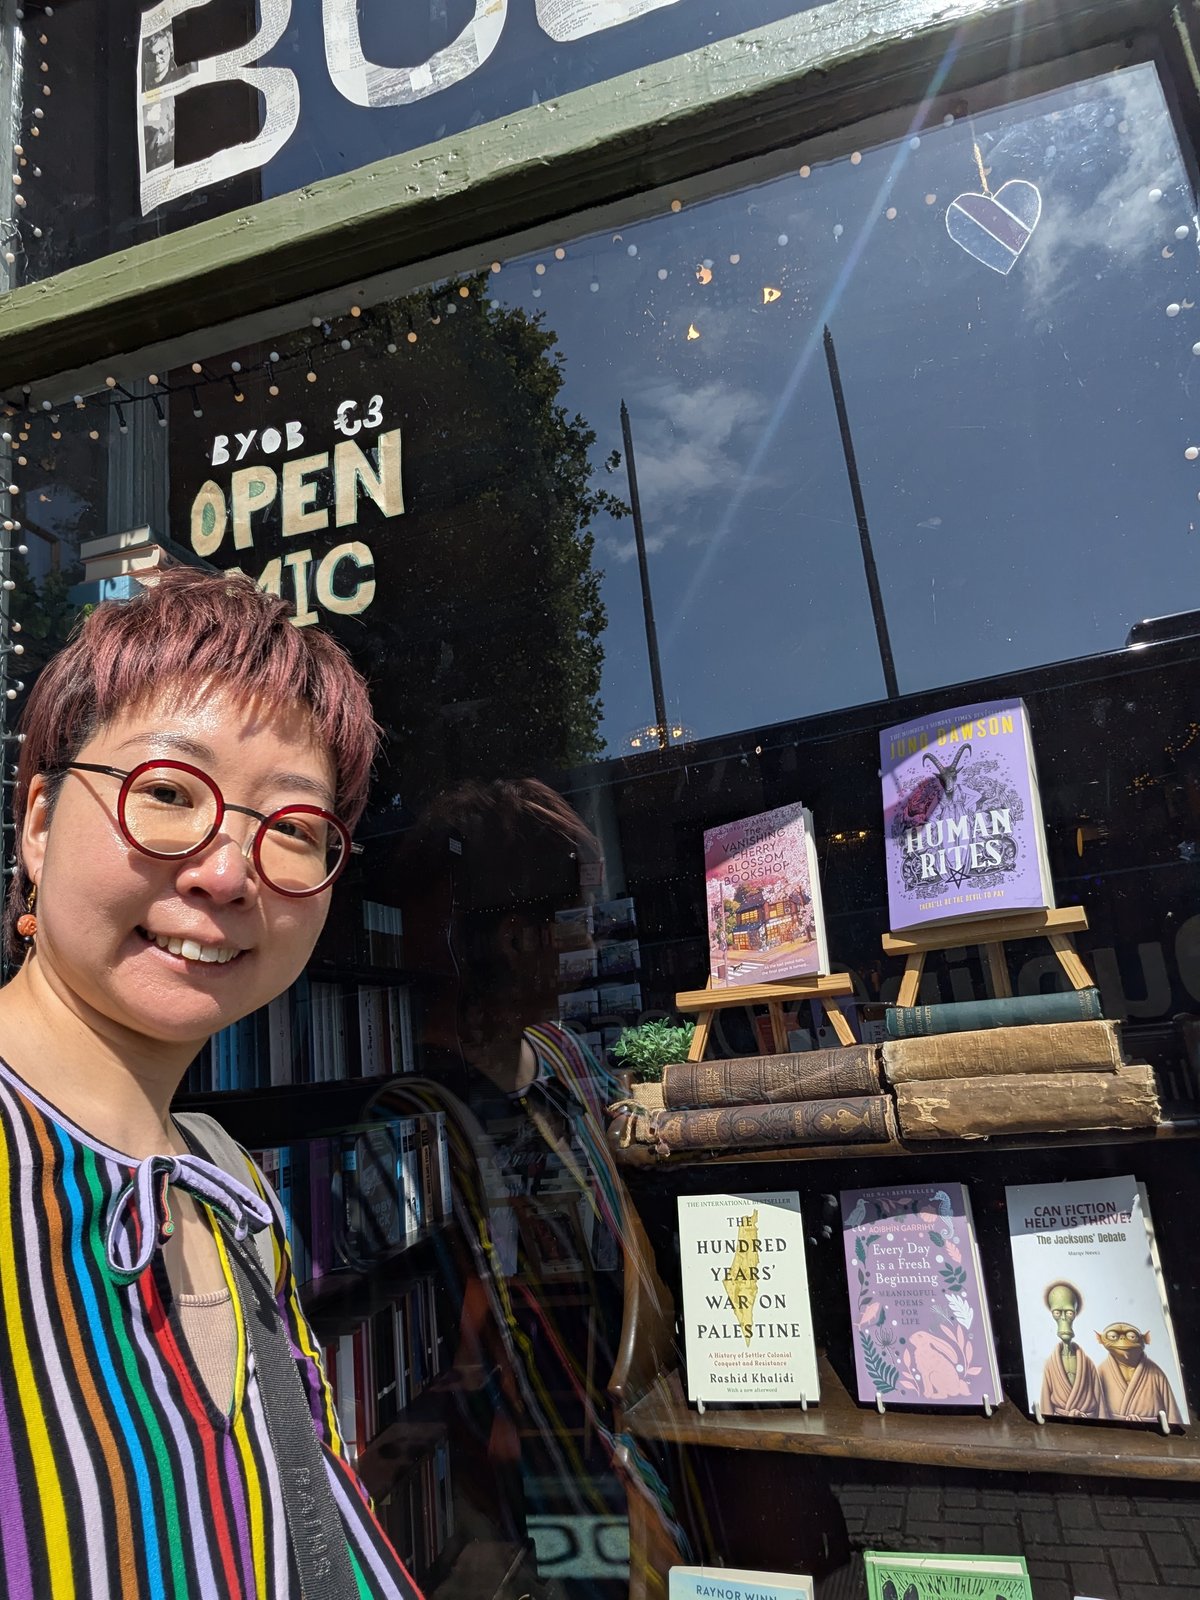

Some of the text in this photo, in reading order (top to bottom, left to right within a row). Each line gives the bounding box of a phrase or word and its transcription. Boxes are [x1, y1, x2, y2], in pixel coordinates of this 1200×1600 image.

[212, 395, 383, 466] BYOB €3
[191, 428, 405, 557] OPEN
[890, 715, 1014, 760] JUNO DAWSON
[744, 826, 760, 836] The
[904, 809, 1012, 854] HUMAN
[722, 828, 786, 852] VANISHING
[732, 842, 776, 861] CHERRY
[920, 840, 1002, 879] RITES
[728, 851, 784, 874] BLOSSOM
[724, 861, 790, 886] BOOKSHOP
[954, 896, 964, 904] THE
[966, 894, 982, 902] DEVIL
[1034, 1202, 1116, 1217] CAN FICTION
[726, 1216, 752, 1227] THE
[900, 1223, 935, 1232] GARRIHY
[1024, 1212, 1132, 1228] HELP US THRIVE?
[696, 1238, 787, 1254] HUNDRED
[1036, 1232, 1126, 1245] The Jacksons' Debate
[872, 1242, 930, 1257] Every Day
[876, 1260, 885, 1270] is
[898, 1258, 931, 1270] Fresh
[710, 1264, 775, 1281] YEARS'
[876, 1273, 939, 1288] Beginning
[705, 1294, 787, 1309] WAR ON
[697, 1323, 801, 1339] PALESTINE
[710, 1373, 794, 1384] Rashid Khalidi
[696, 1585, 740, 1600] RAYNOR
